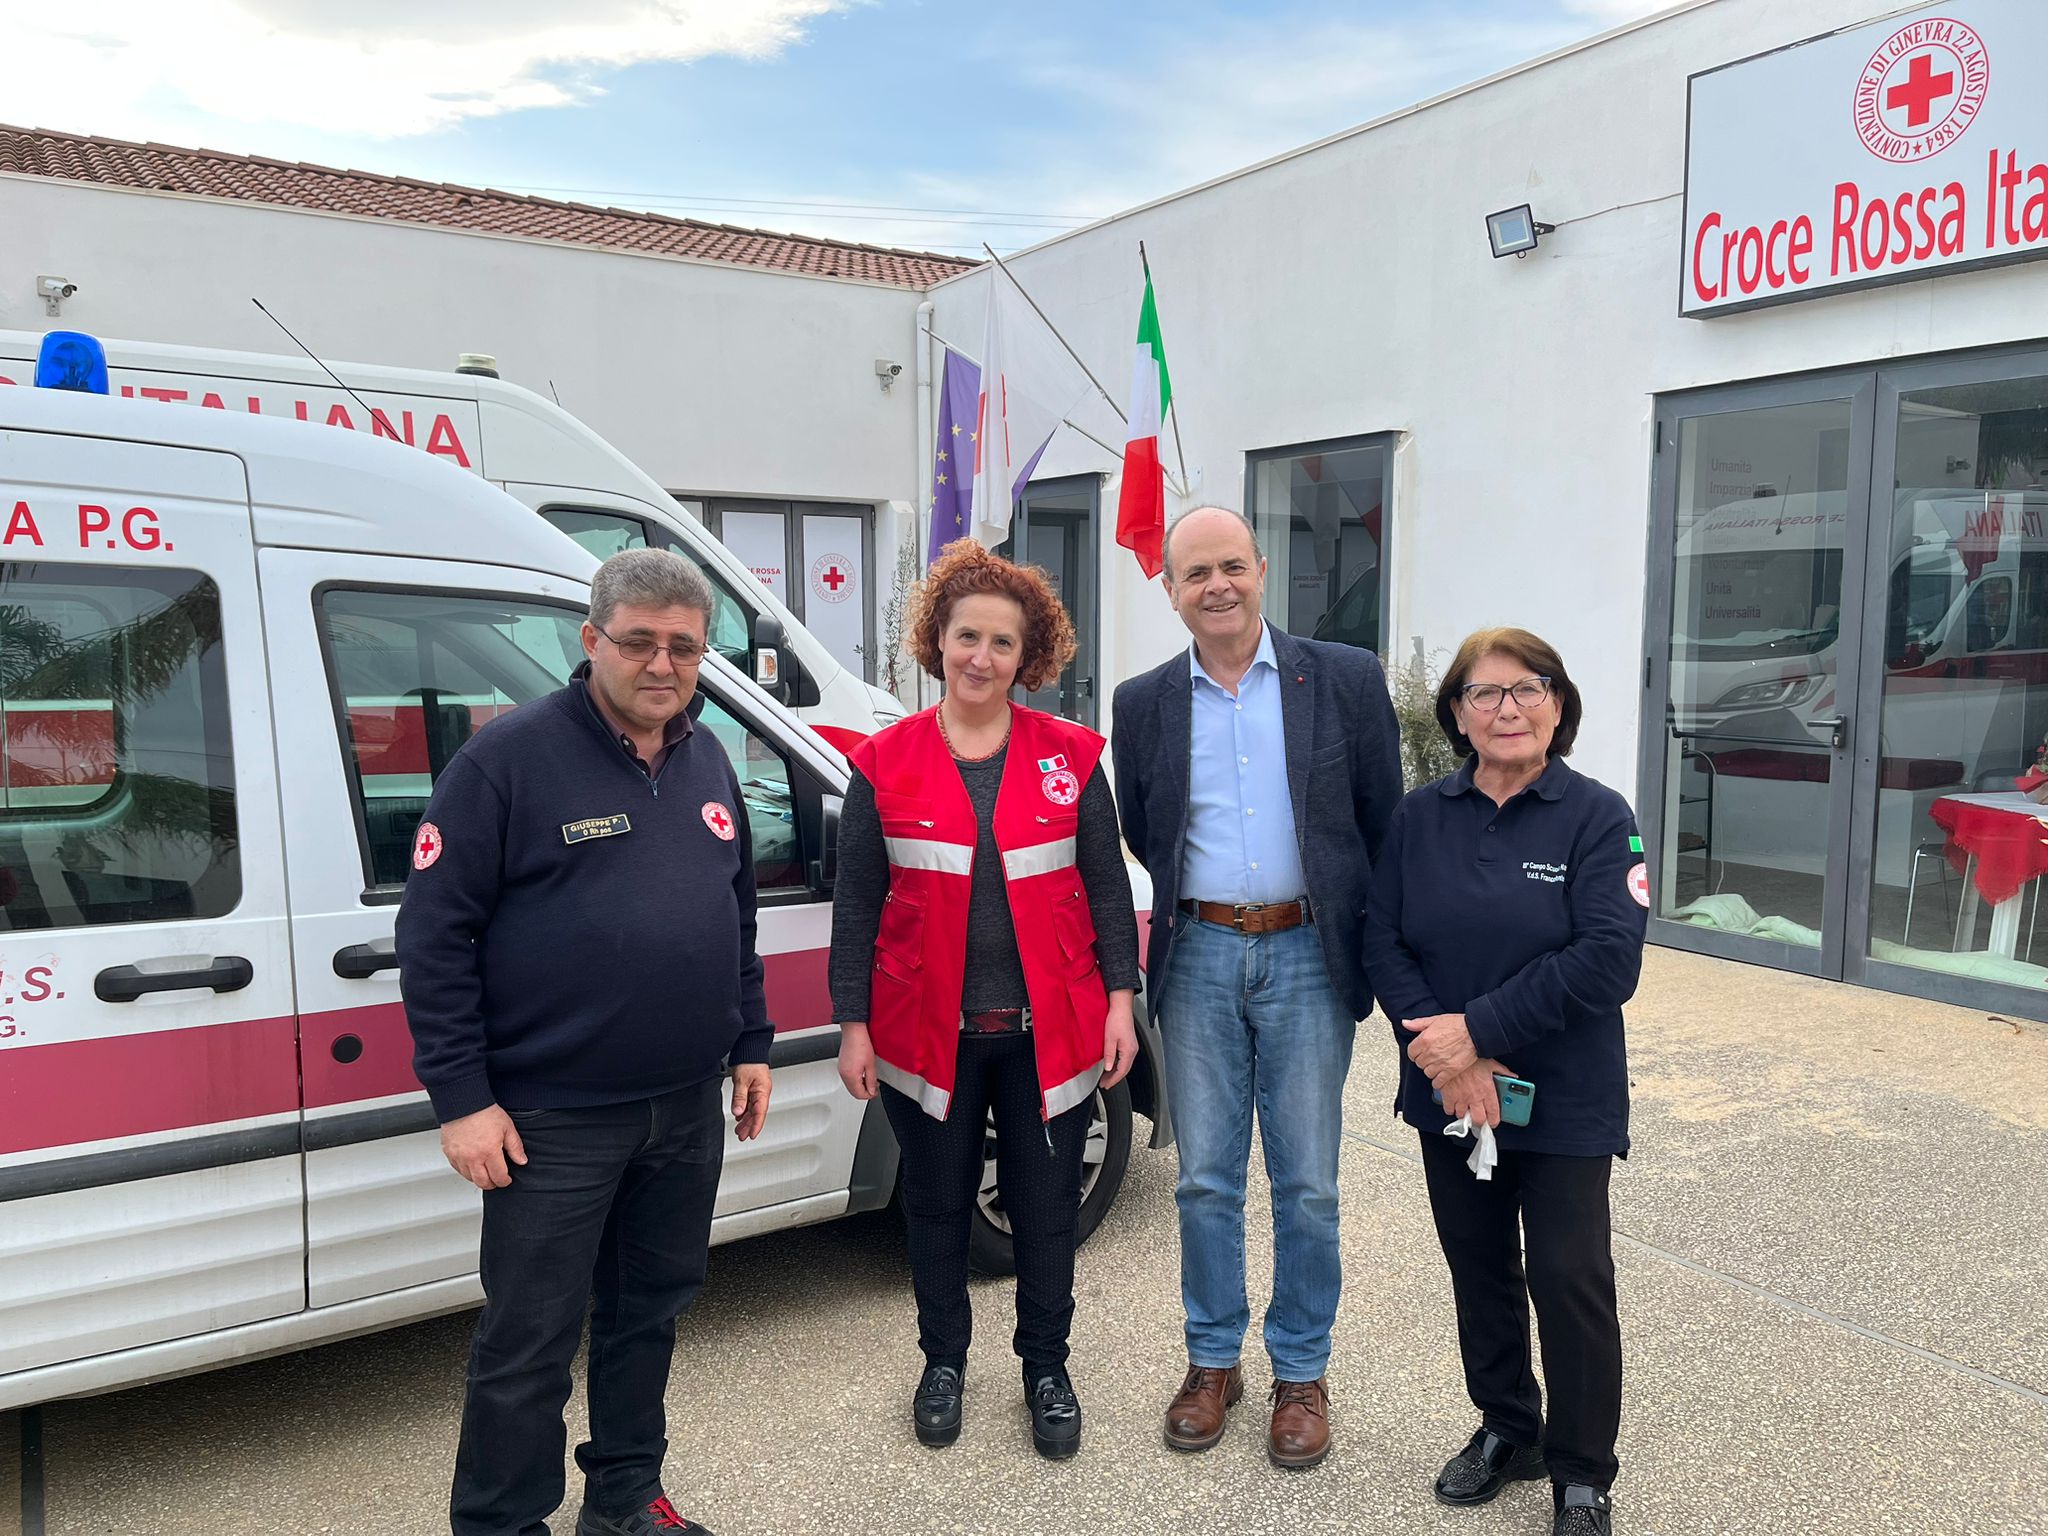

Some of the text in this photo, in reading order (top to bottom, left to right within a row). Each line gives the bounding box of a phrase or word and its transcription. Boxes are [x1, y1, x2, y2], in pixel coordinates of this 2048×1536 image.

[1858, 21, 1986, 158] CONVENZIONE DI GINEVRA 22 AGOSTO 1864
[1693, 211, 1813, 302] Croce
[1830, 181, 1966, 277] Rossa
[79, 505, 174, 551] P.G.
[756, 567, 781, 575] ROSSA
[570, 820, 611, 832] GIUSEPPE
[600, 827, 612, 835] pos
